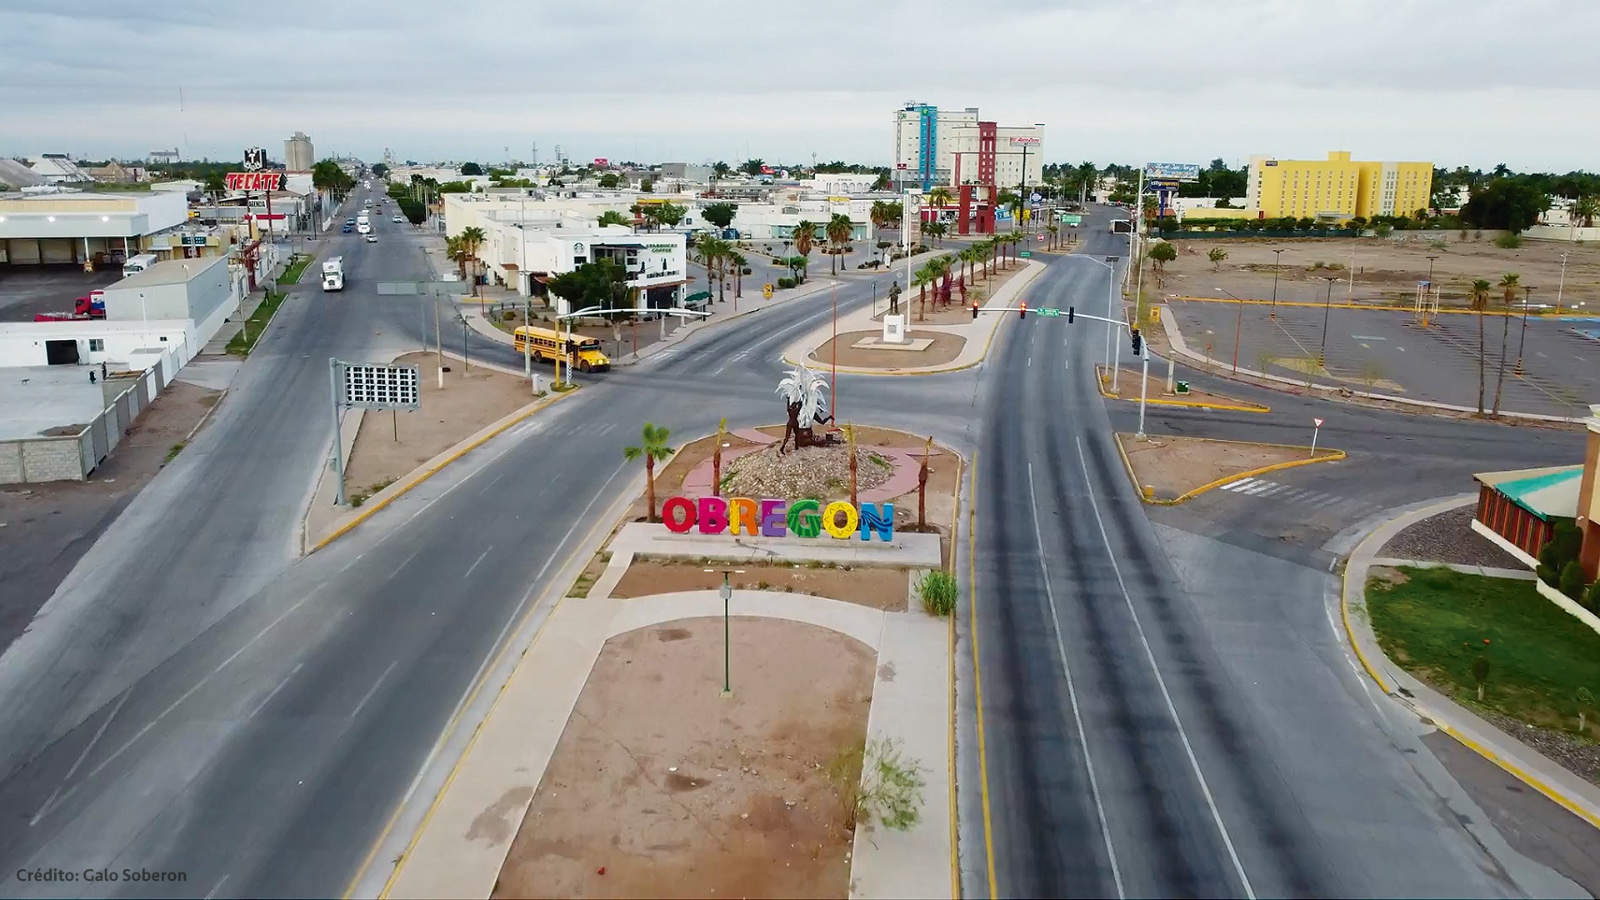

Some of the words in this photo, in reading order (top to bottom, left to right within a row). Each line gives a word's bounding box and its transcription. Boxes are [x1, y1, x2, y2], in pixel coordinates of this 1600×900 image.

[225, 172, 280, 191] TECATE
[248, 200, 266, 208] AGENCIA
[662, 496, 894, 542] OBREGON
